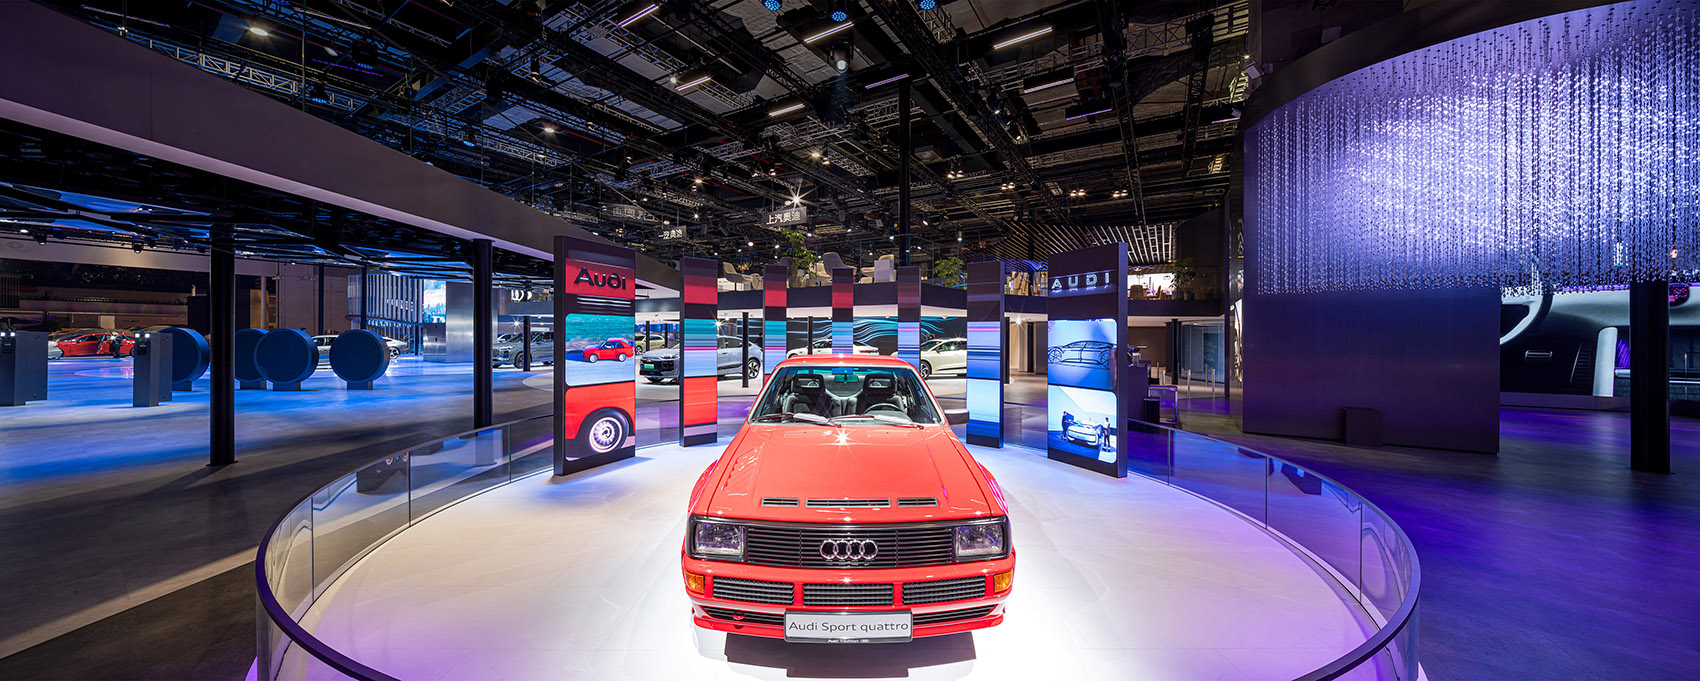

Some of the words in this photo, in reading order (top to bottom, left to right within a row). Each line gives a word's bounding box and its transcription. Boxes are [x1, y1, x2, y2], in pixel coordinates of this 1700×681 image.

[766, 211, 800, 225] 上汽奥迪
[573, 267, 626, 290] Audi
[1051, 272, 1110, 289] AUDI
[788, 621, 818, 631] Audi
[821, 622, 857, 633] Sport
[860, 622, 909, 633] quattro
